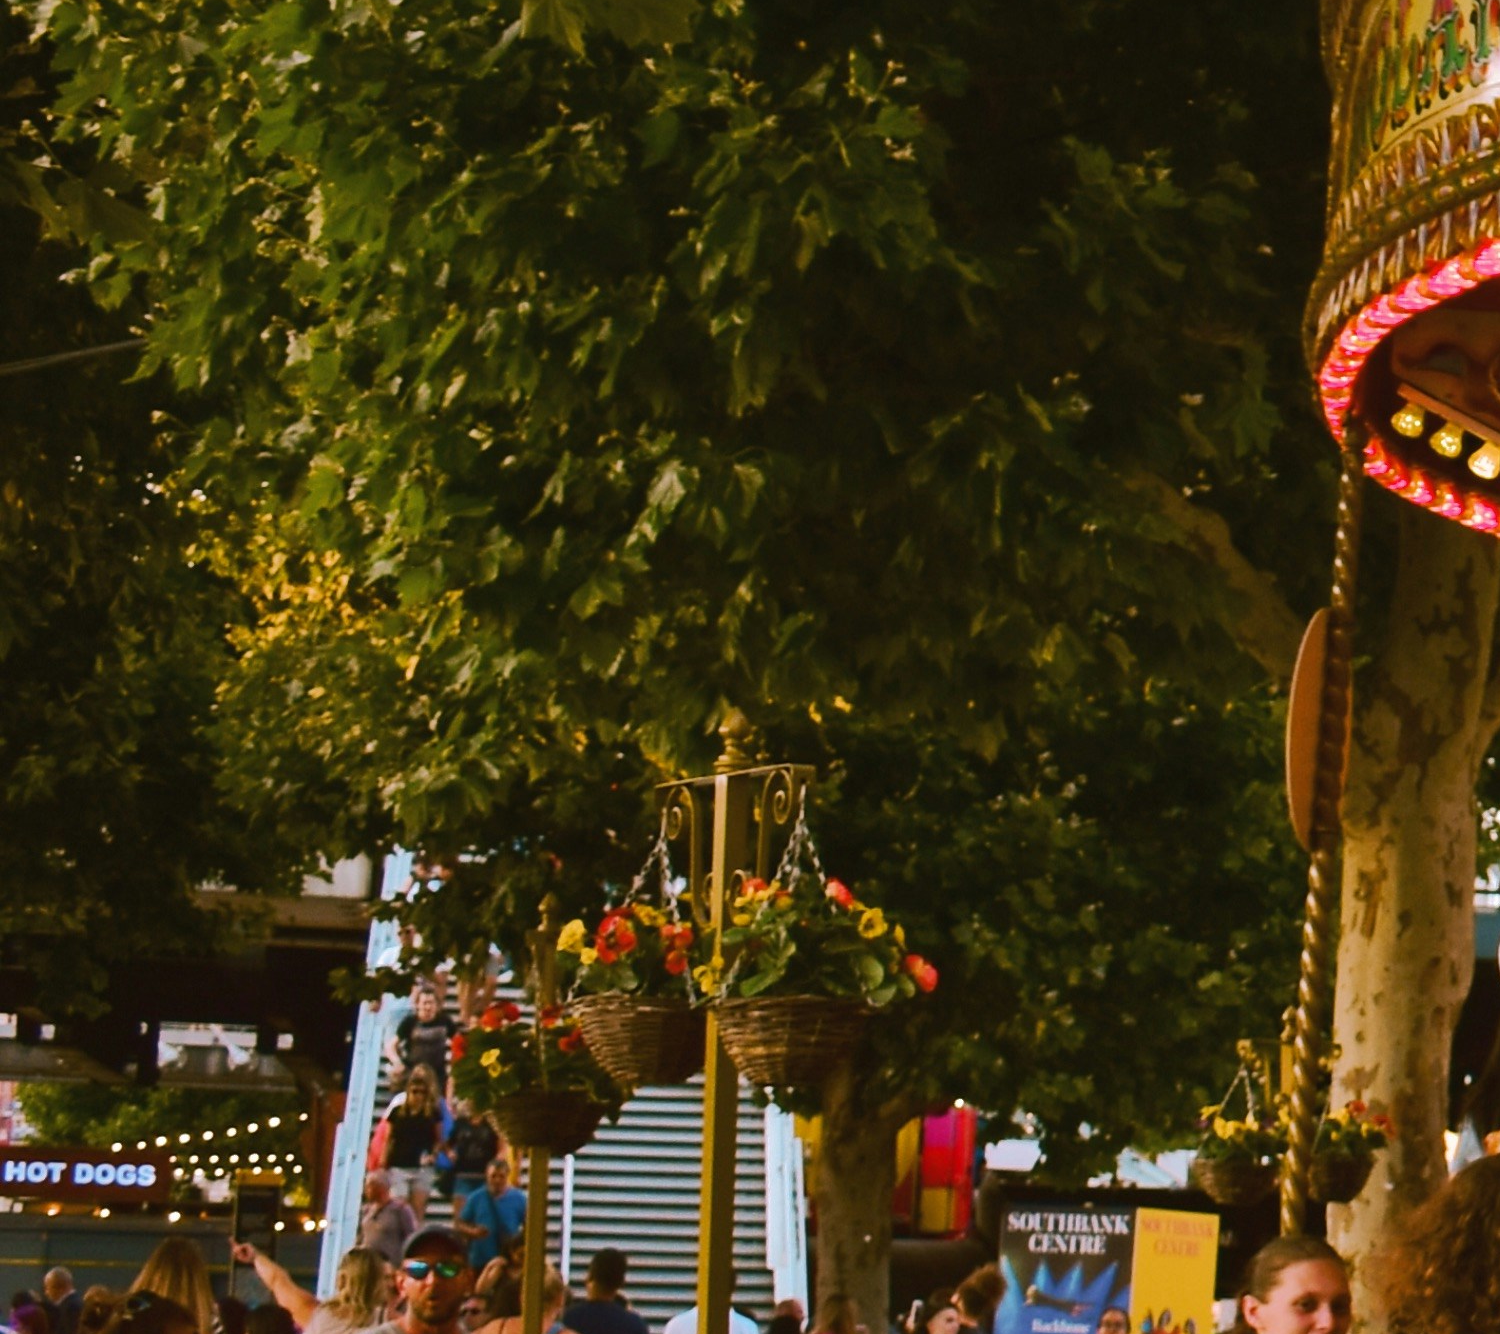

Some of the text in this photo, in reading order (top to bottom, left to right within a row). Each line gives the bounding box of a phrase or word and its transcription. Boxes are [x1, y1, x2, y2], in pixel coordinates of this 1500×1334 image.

[4, 1160, 157, 1187] HOT DOGS
[1007, 1211, 1131, 1235] SOUTHBANK
[1027, 1232, 1107, 1255] CENTRE
